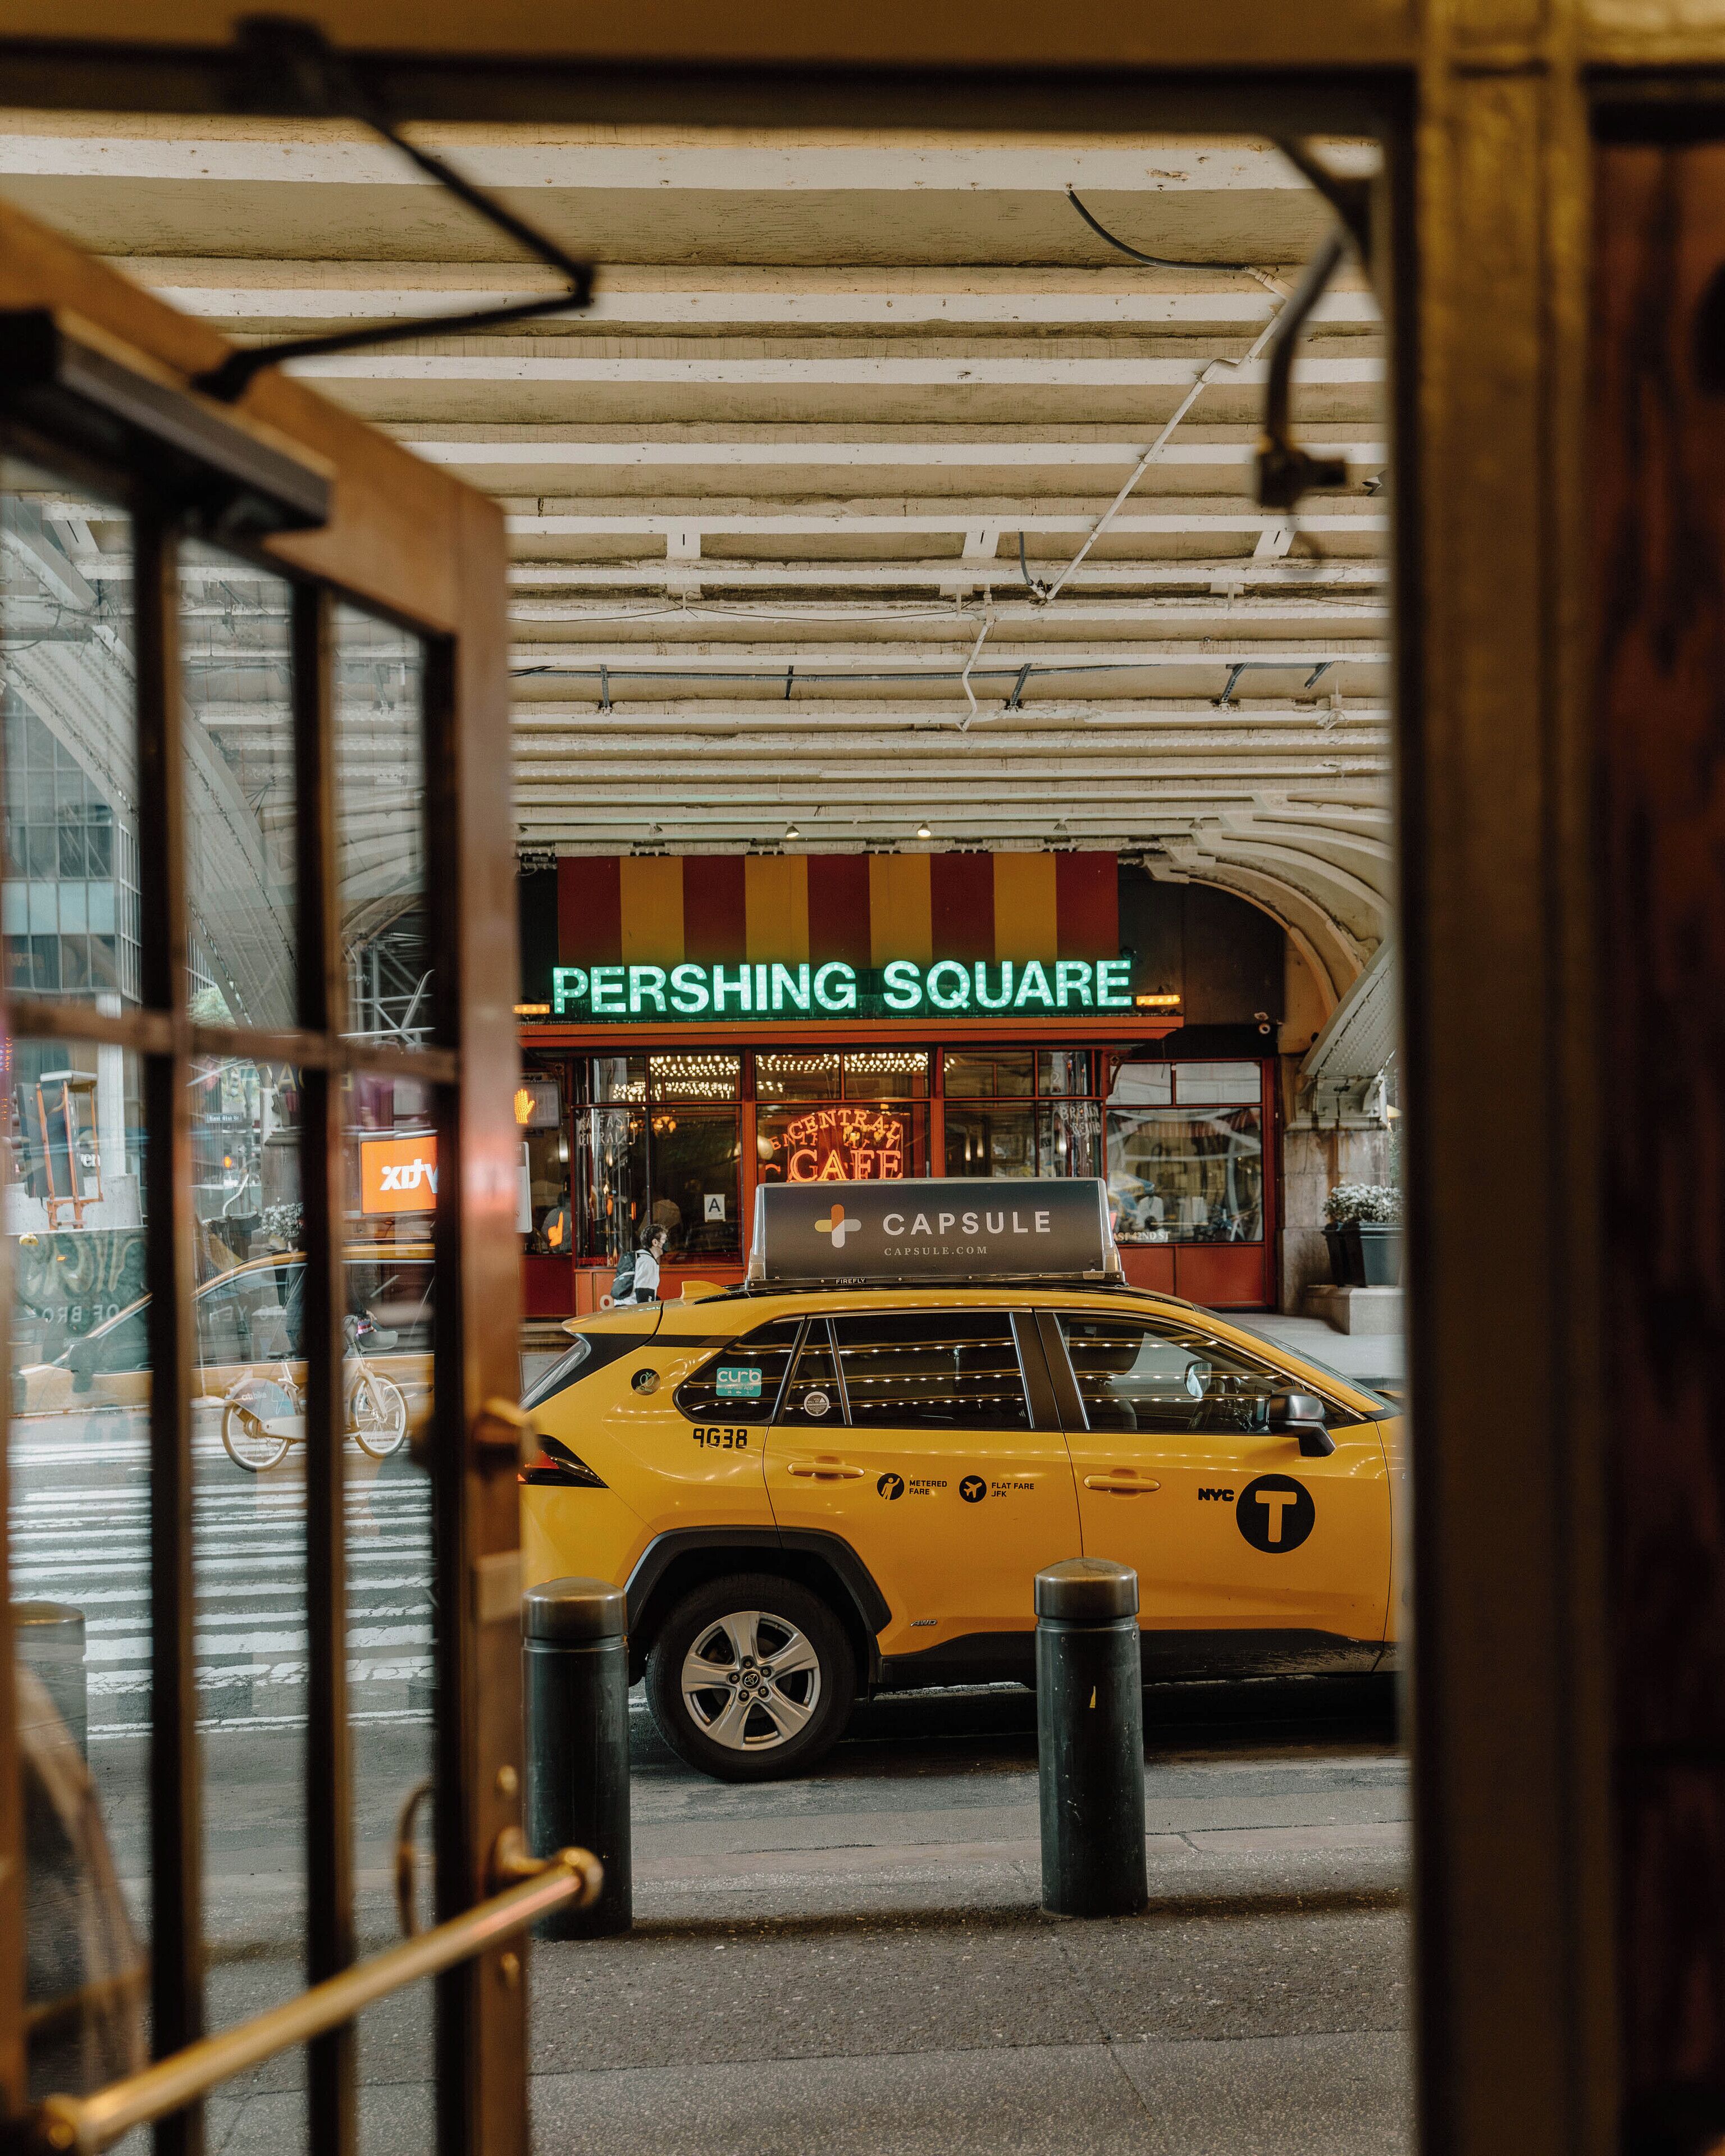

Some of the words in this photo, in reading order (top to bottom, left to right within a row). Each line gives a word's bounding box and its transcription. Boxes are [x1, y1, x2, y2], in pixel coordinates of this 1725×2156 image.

[553, 962, 856, 1014] PERSHING
[883, 960, 1133, 1010] SQUARE
[788, 1109, 901, 1140] CENTRAL
[708, 1197, 721, 1213] A
[882, 1211, 1051, 1236] CAPSULE
[884, 1245, 988, 1256] CAPSULE.COM
[718, 1369, 761, 1383] curb
[692, 1427, 748, 1449] 9G38
[909, 1479, 947, 1488] METERED
[1198, 1488, 1234, 1502] NYC
[1255, 1490, 1298, 1543] T
